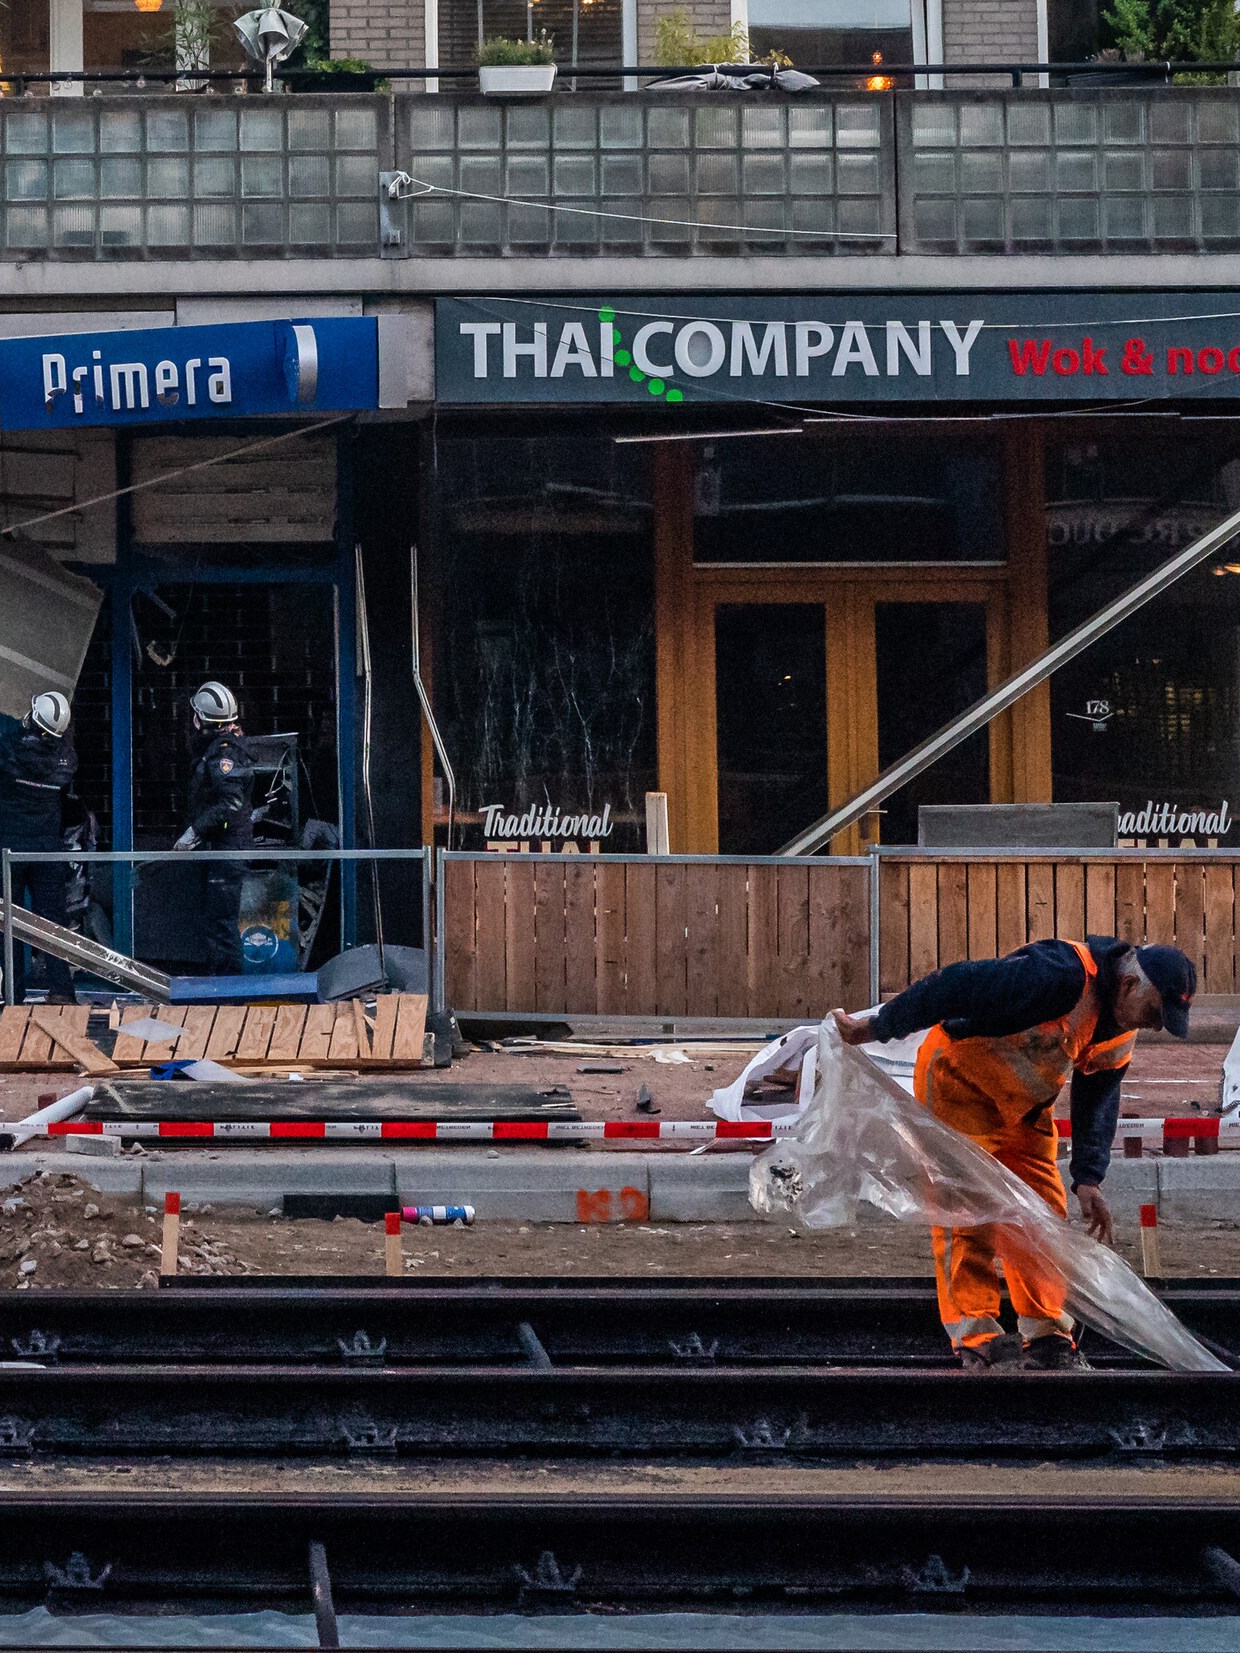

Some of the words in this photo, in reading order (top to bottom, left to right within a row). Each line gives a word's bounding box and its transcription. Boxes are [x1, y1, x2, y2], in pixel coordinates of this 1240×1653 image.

[460, 321, 614, 378] THAI
[632, 320, 985, 379] COMPANY
[1007, 337, 1108, 376] Wok
[1121, 337, 1154, 376] &
[42, 350, 232, 414] Primera
[1086, 700, 1110, 714] 178
[478, 803, 613, 837] Traditional
